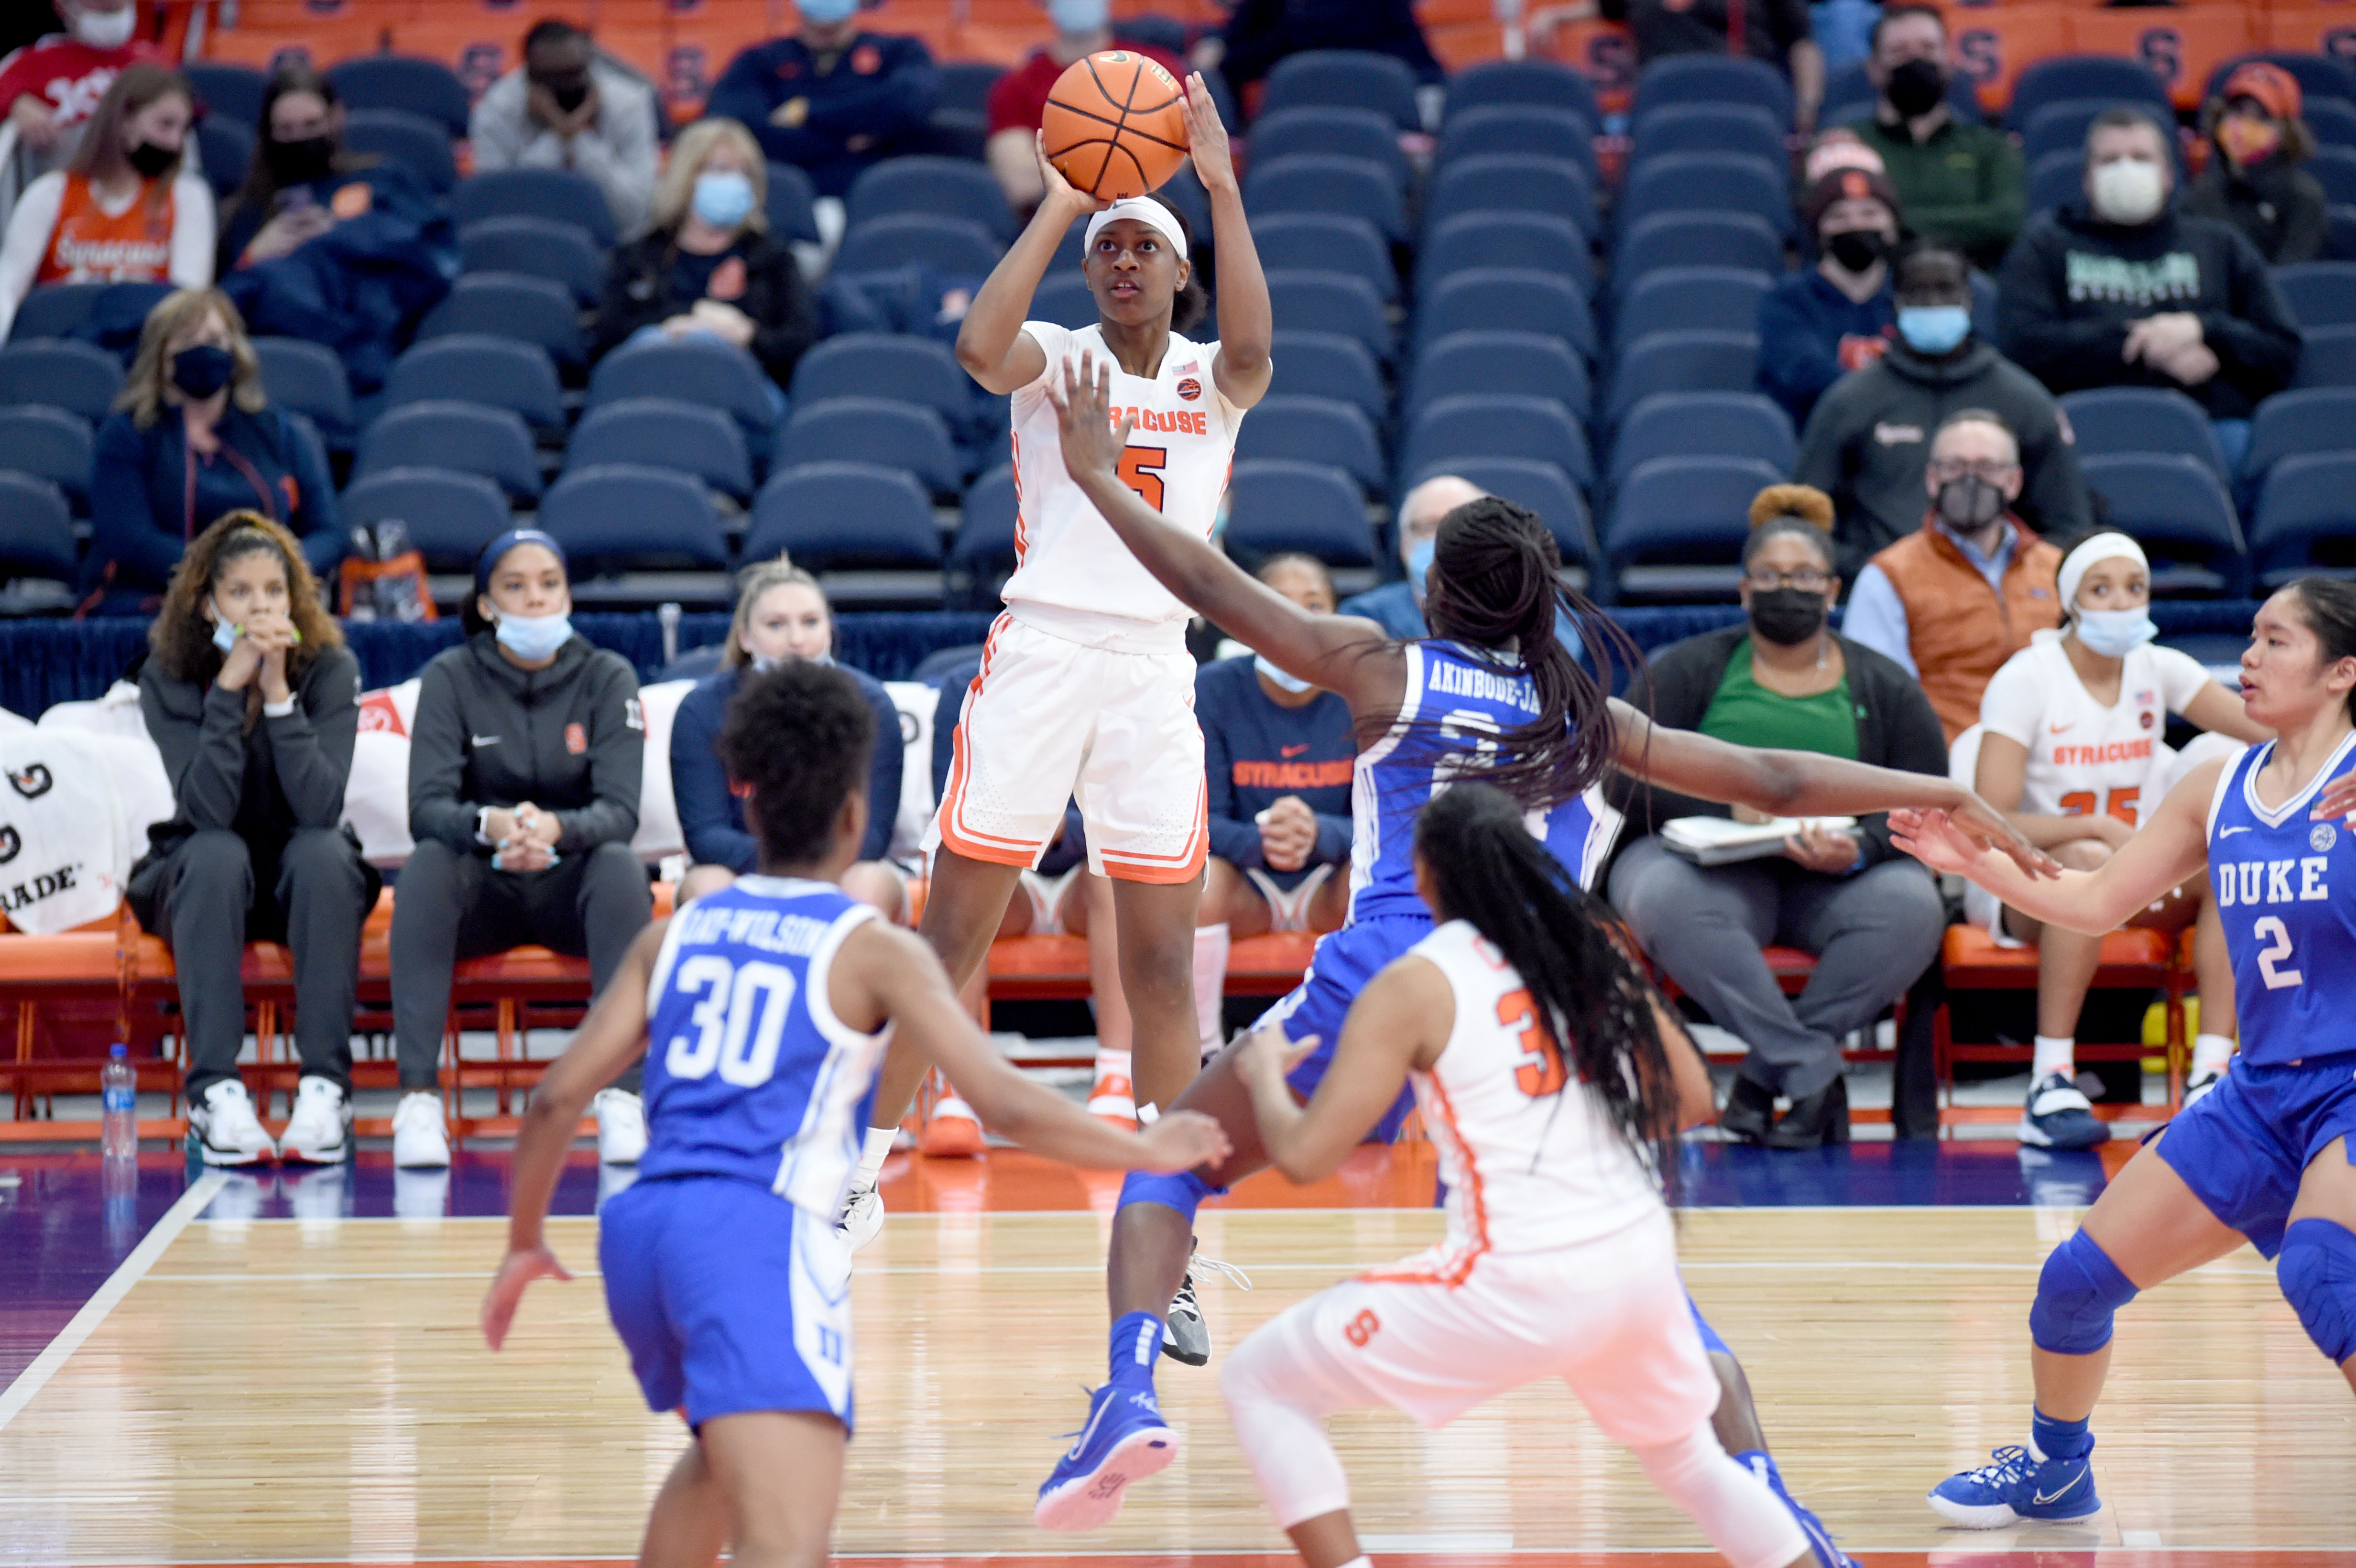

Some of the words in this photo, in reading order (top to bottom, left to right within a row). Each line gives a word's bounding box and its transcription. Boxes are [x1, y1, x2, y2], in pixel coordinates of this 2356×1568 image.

[1108, 406, 1207, 435] RACUSE
[1114, 445, 1167, 513] 5
[1428, 660, 1542, 715] AKINBODE-JA
[2053, 737, 2152, 766] SYRACUSE
[2219, 856, 2328, 907] DUKE
[2254, 915, 2303, 990] 2
[665, 954, 796, 1088] 30
[1495, 985, 1586, 1100] 3
